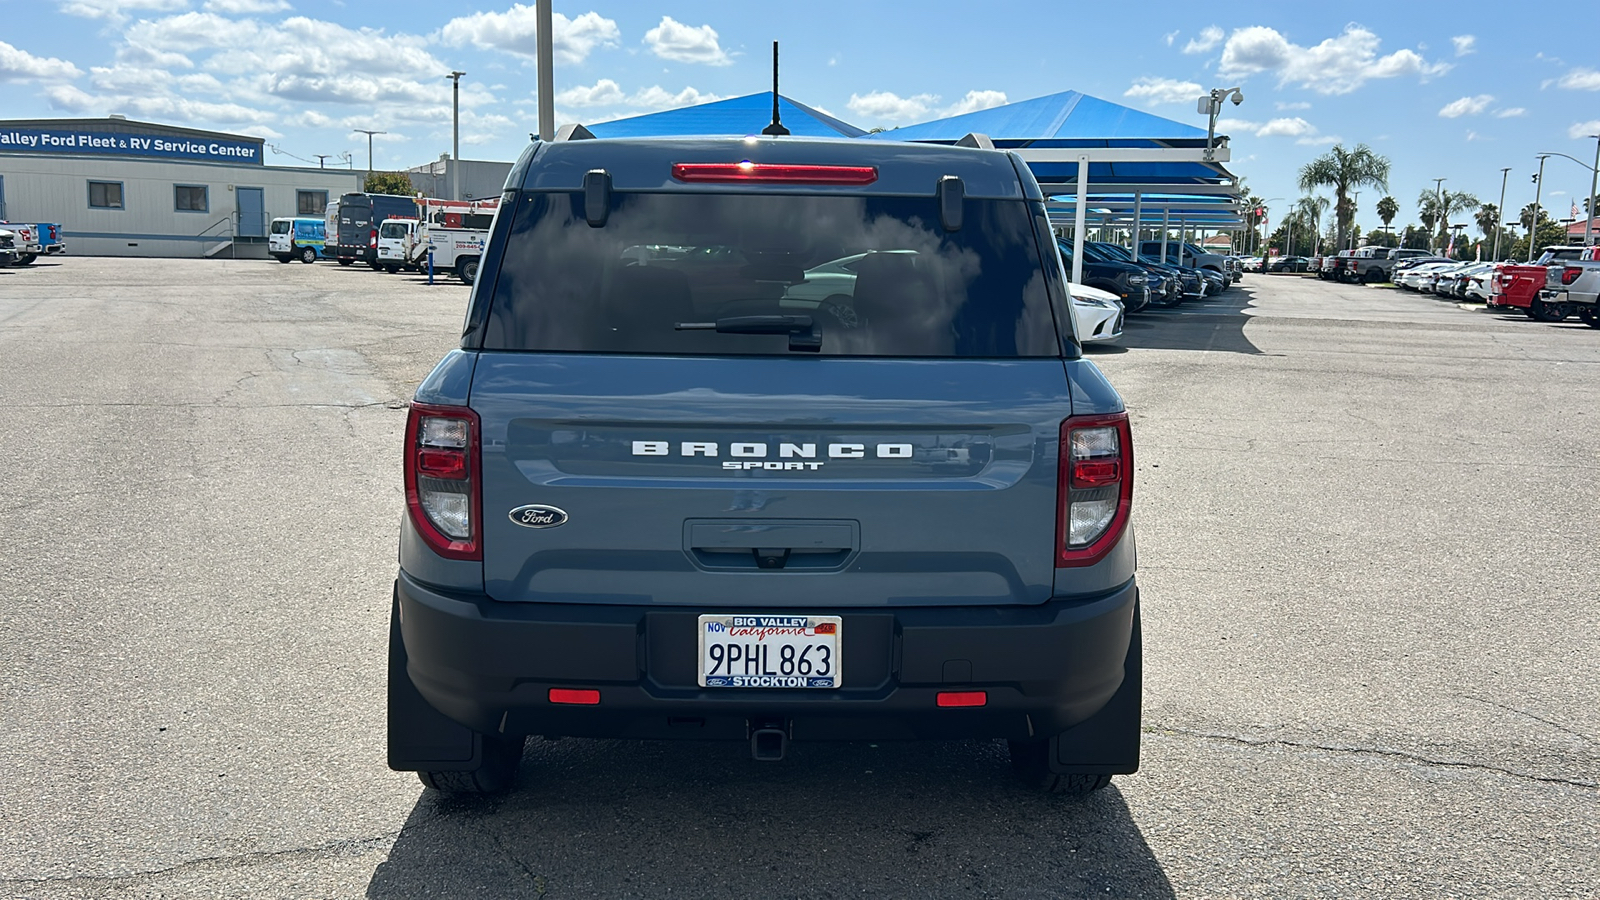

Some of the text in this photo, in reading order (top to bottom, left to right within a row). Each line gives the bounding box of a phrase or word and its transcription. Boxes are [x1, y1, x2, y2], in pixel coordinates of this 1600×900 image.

[0, 132, 255, 158] alley Ford Fleet & RV Service Center
[632, 441, 913, 458] BRONCO
[722, 461, 825, 470] SPORT
[521, 509, 554, 524] Ford
[707, 622, 726, 633] NOV
[734, 618, 807, 627] BIG VALLEY
[729, 626, 815, 641] California
[708, 643, 831, 676] 9PHL863
[732, 676, 808, 687] STOCKTON
